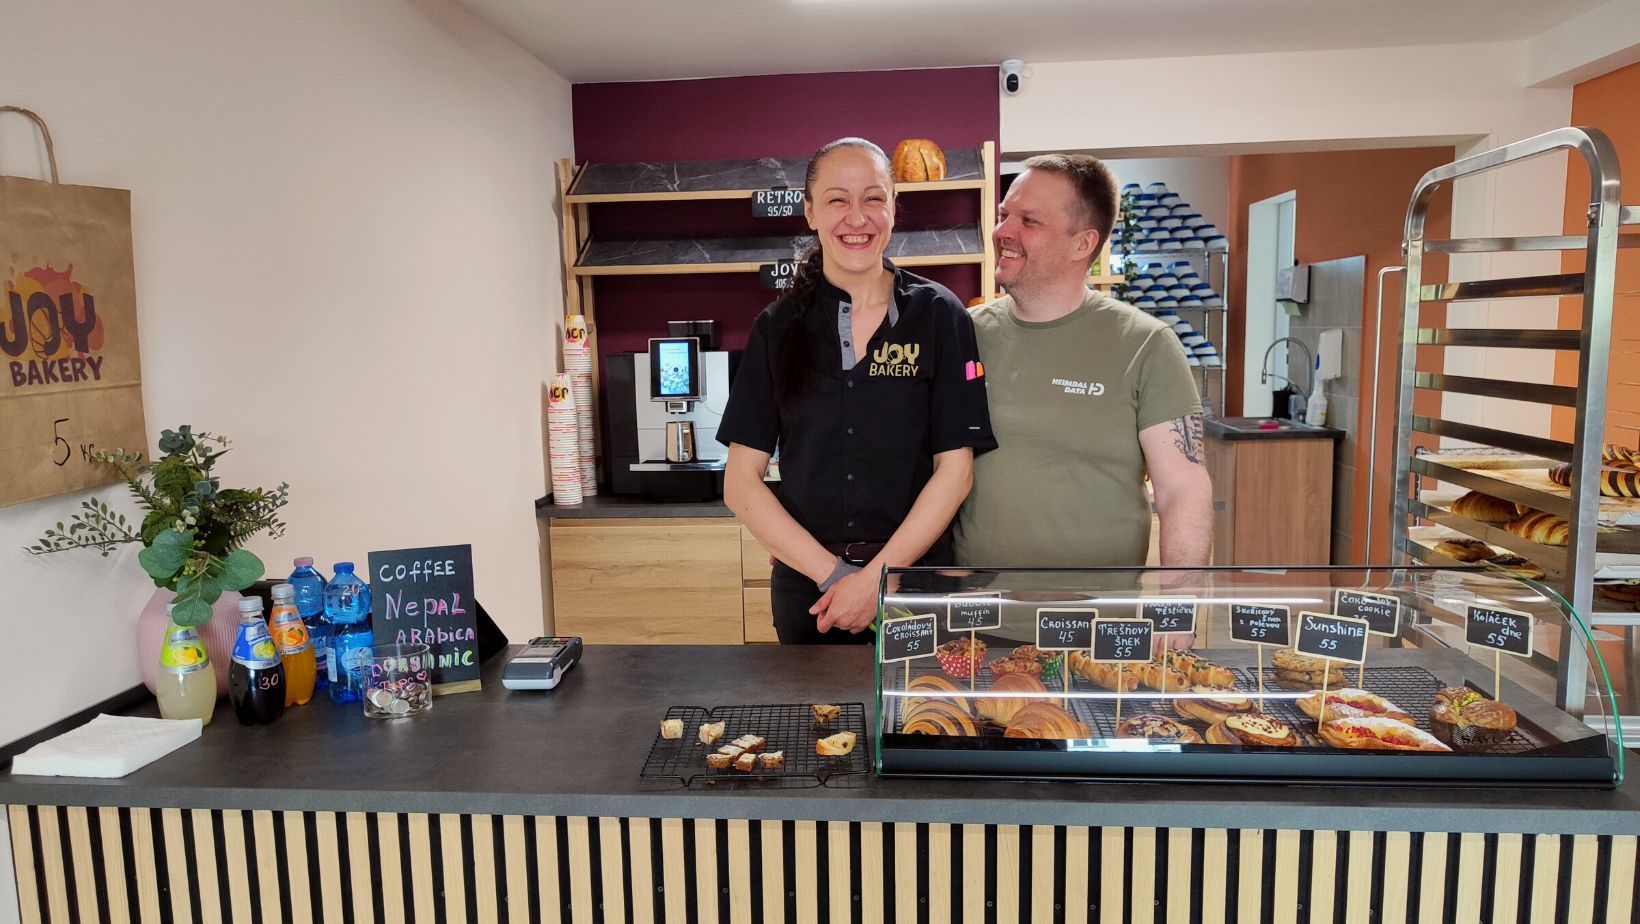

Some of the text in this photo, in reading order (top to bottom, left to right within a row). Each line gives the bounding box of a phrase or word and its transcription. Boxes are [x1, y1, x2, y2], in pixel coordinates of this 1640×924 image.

[757, 190, 802, 204] RETRO
[767, 205, 793, 217] 95/50
[770, 263, 799, 277] JOY
[0, 290, 97, 357] JOY
[873, 341, 920, 365] JOY
[9, 355, 104, 387] BAKERY
[869, 362, 919, 377] BAKERY
[1051, 378, 1088, 389] HEIMDAL
[1064, 386, 1086, 395] DATA
[53, 417, 70, 467] 5
[960, 608, 990, 619] muffin
[967, 616, 984, 628] 45
[1159, 617, 1179, 628] 55
[1058, 630, 1075, 644] 45
[1250, 628, 1267, 638] 55
[1486, 632, 1507, 647] 55
[1501, 626, 1523, 640] dne
[906, 640, 921, 652] 55
[1318, 638, 1338, 650] 55
[1114, 646, 1133, 658] 55
[259, 673, 279, 690] 30
